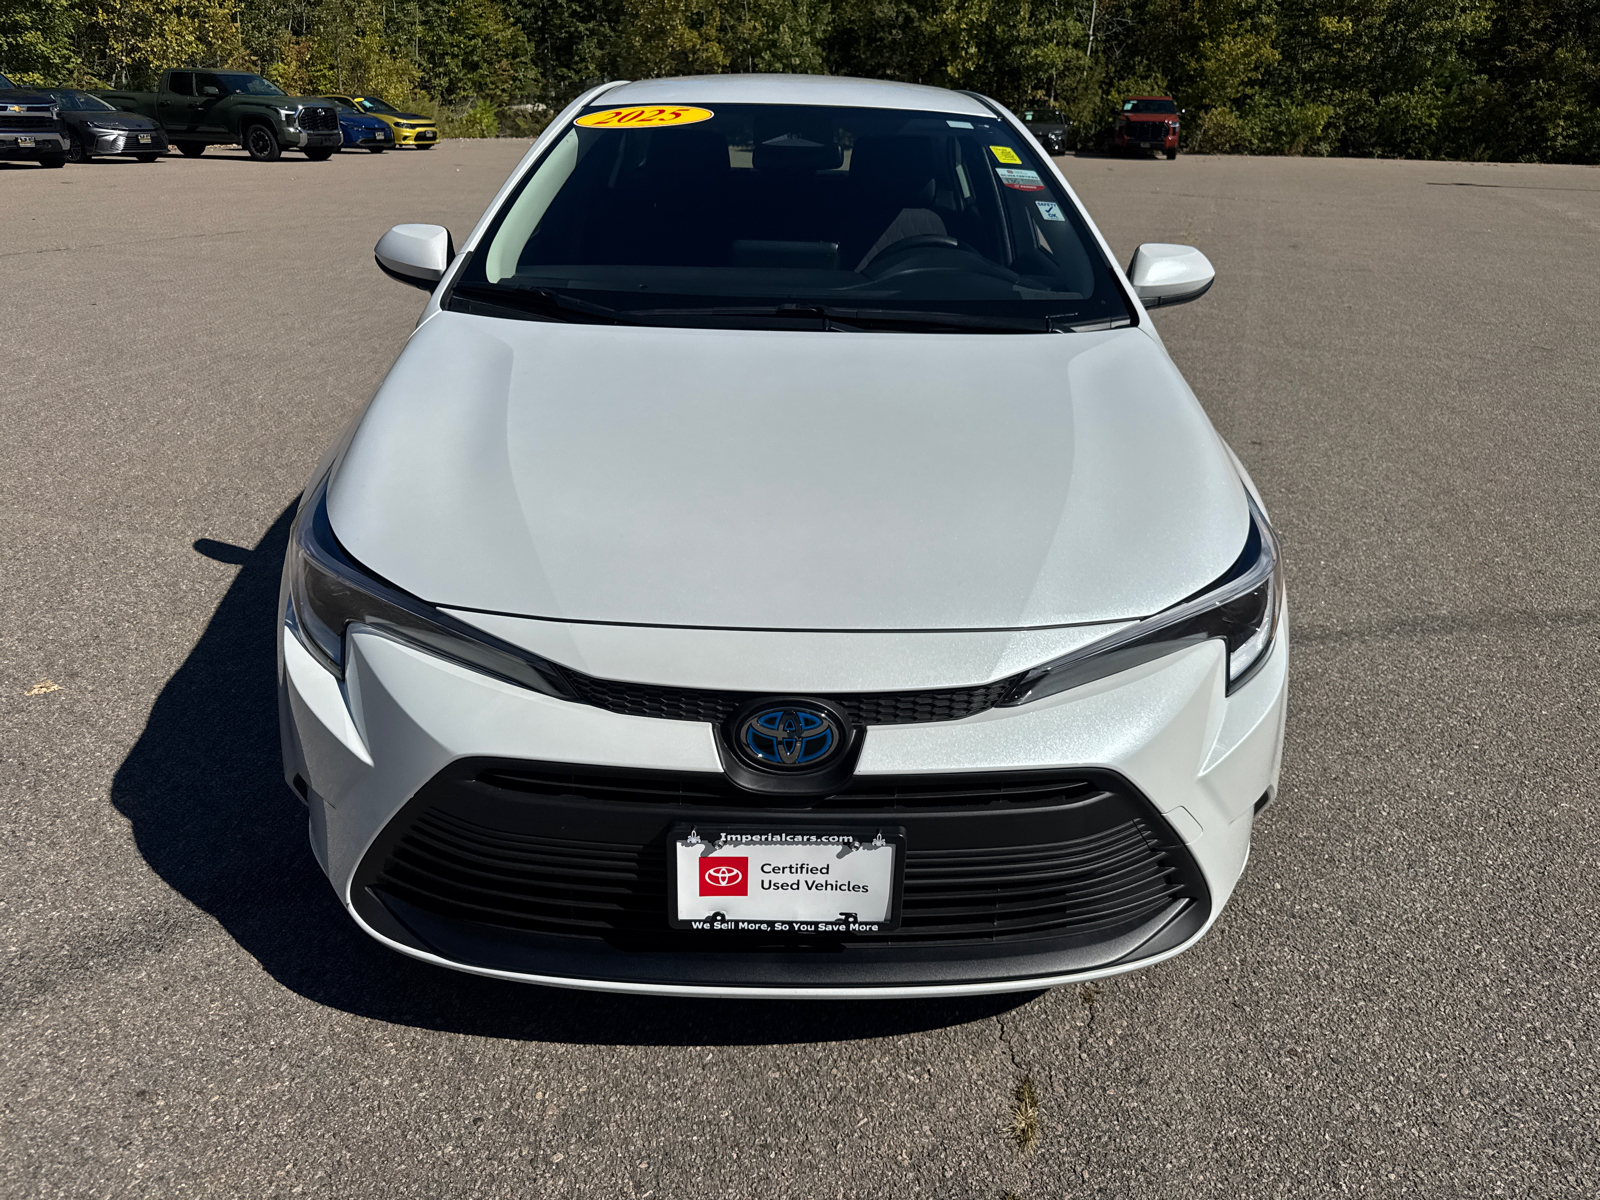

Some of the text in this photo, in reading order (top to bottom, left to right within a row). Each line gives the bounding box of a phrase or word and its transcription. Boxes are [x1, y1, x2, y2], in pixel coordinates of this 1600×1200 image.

[591, 109, 691, 125] 2025
[720, 832, 853, 843] Imperialcars.com
[760, 863, 830, 875] Certified
[760, 879, 869, 893] Used Vehicles
[691, 921, 879, 932] We Sell More, So You Save More
